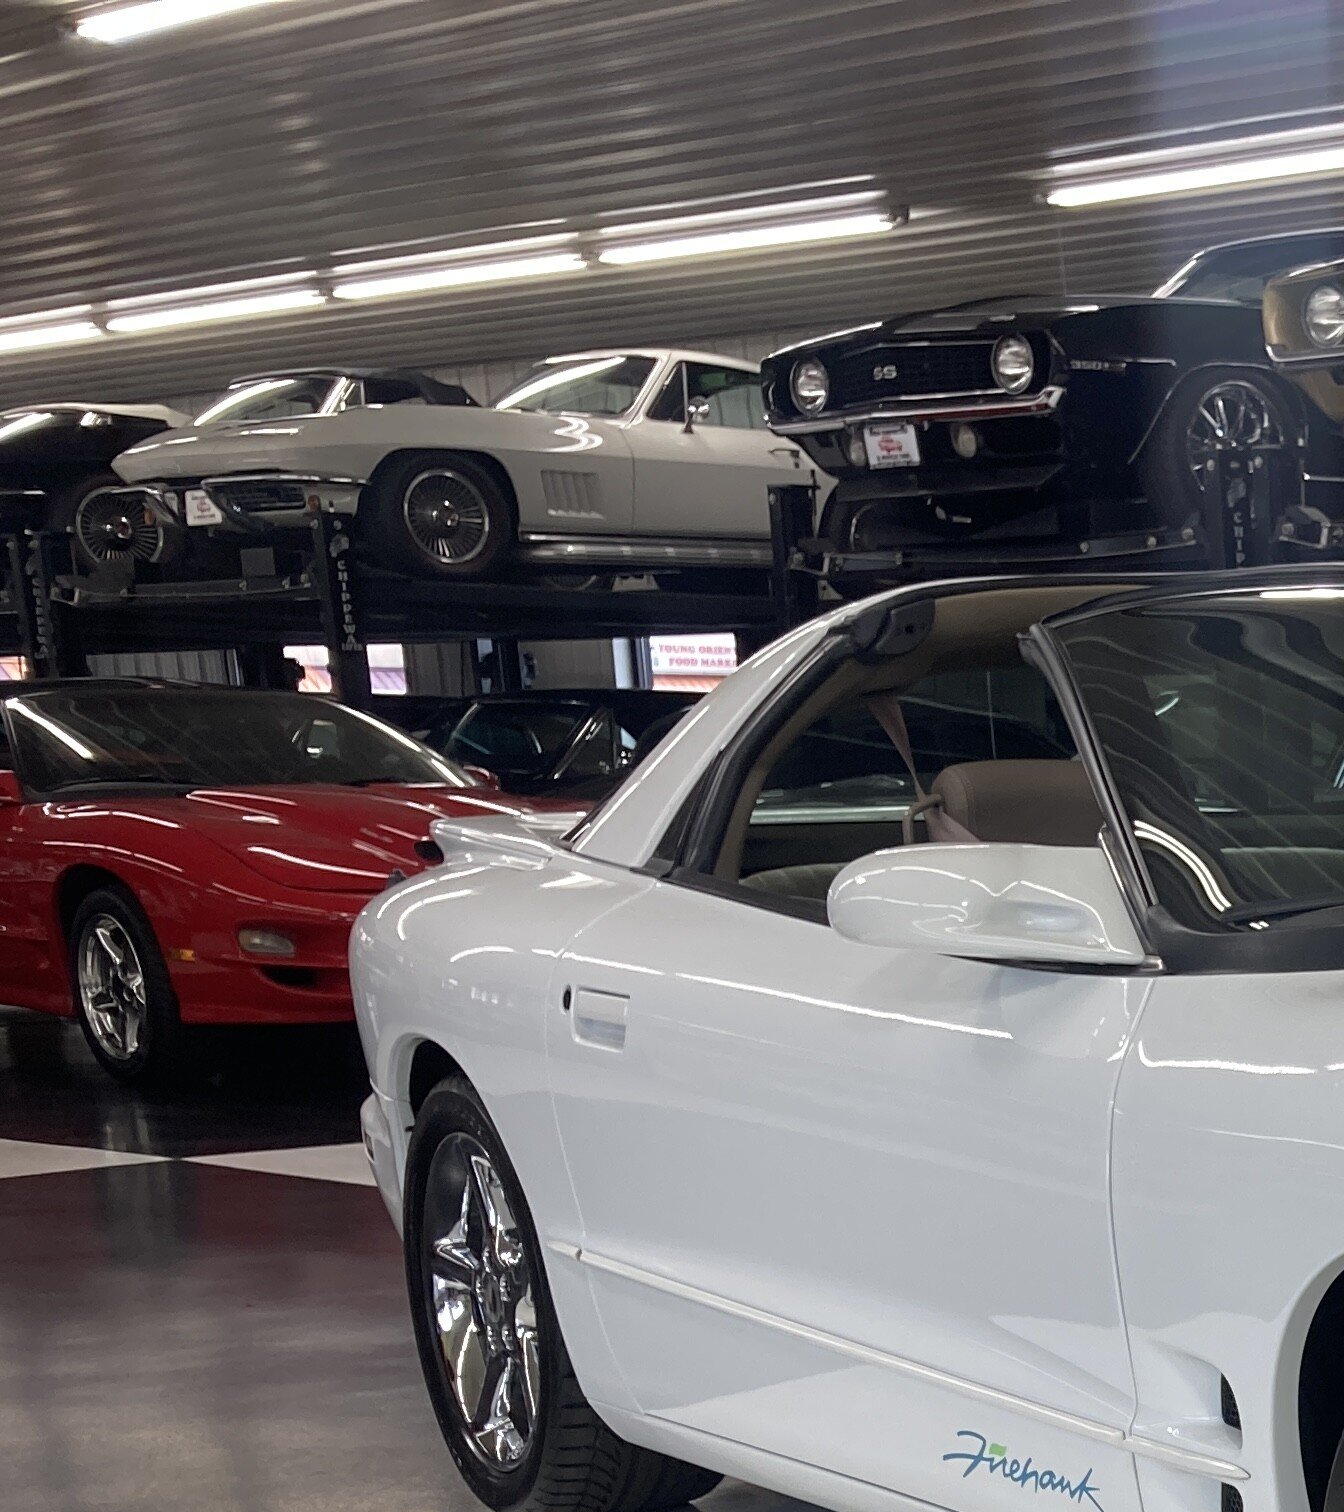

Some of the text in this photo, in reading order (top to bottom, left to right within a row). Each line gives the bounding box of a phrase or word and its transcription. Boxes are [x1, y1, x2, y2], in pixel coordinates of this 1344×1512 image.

[873, 365, 897, 381] SS
[659, 644, 695, 654] YOUNG
[669, 657, 698, 667] FOOD
